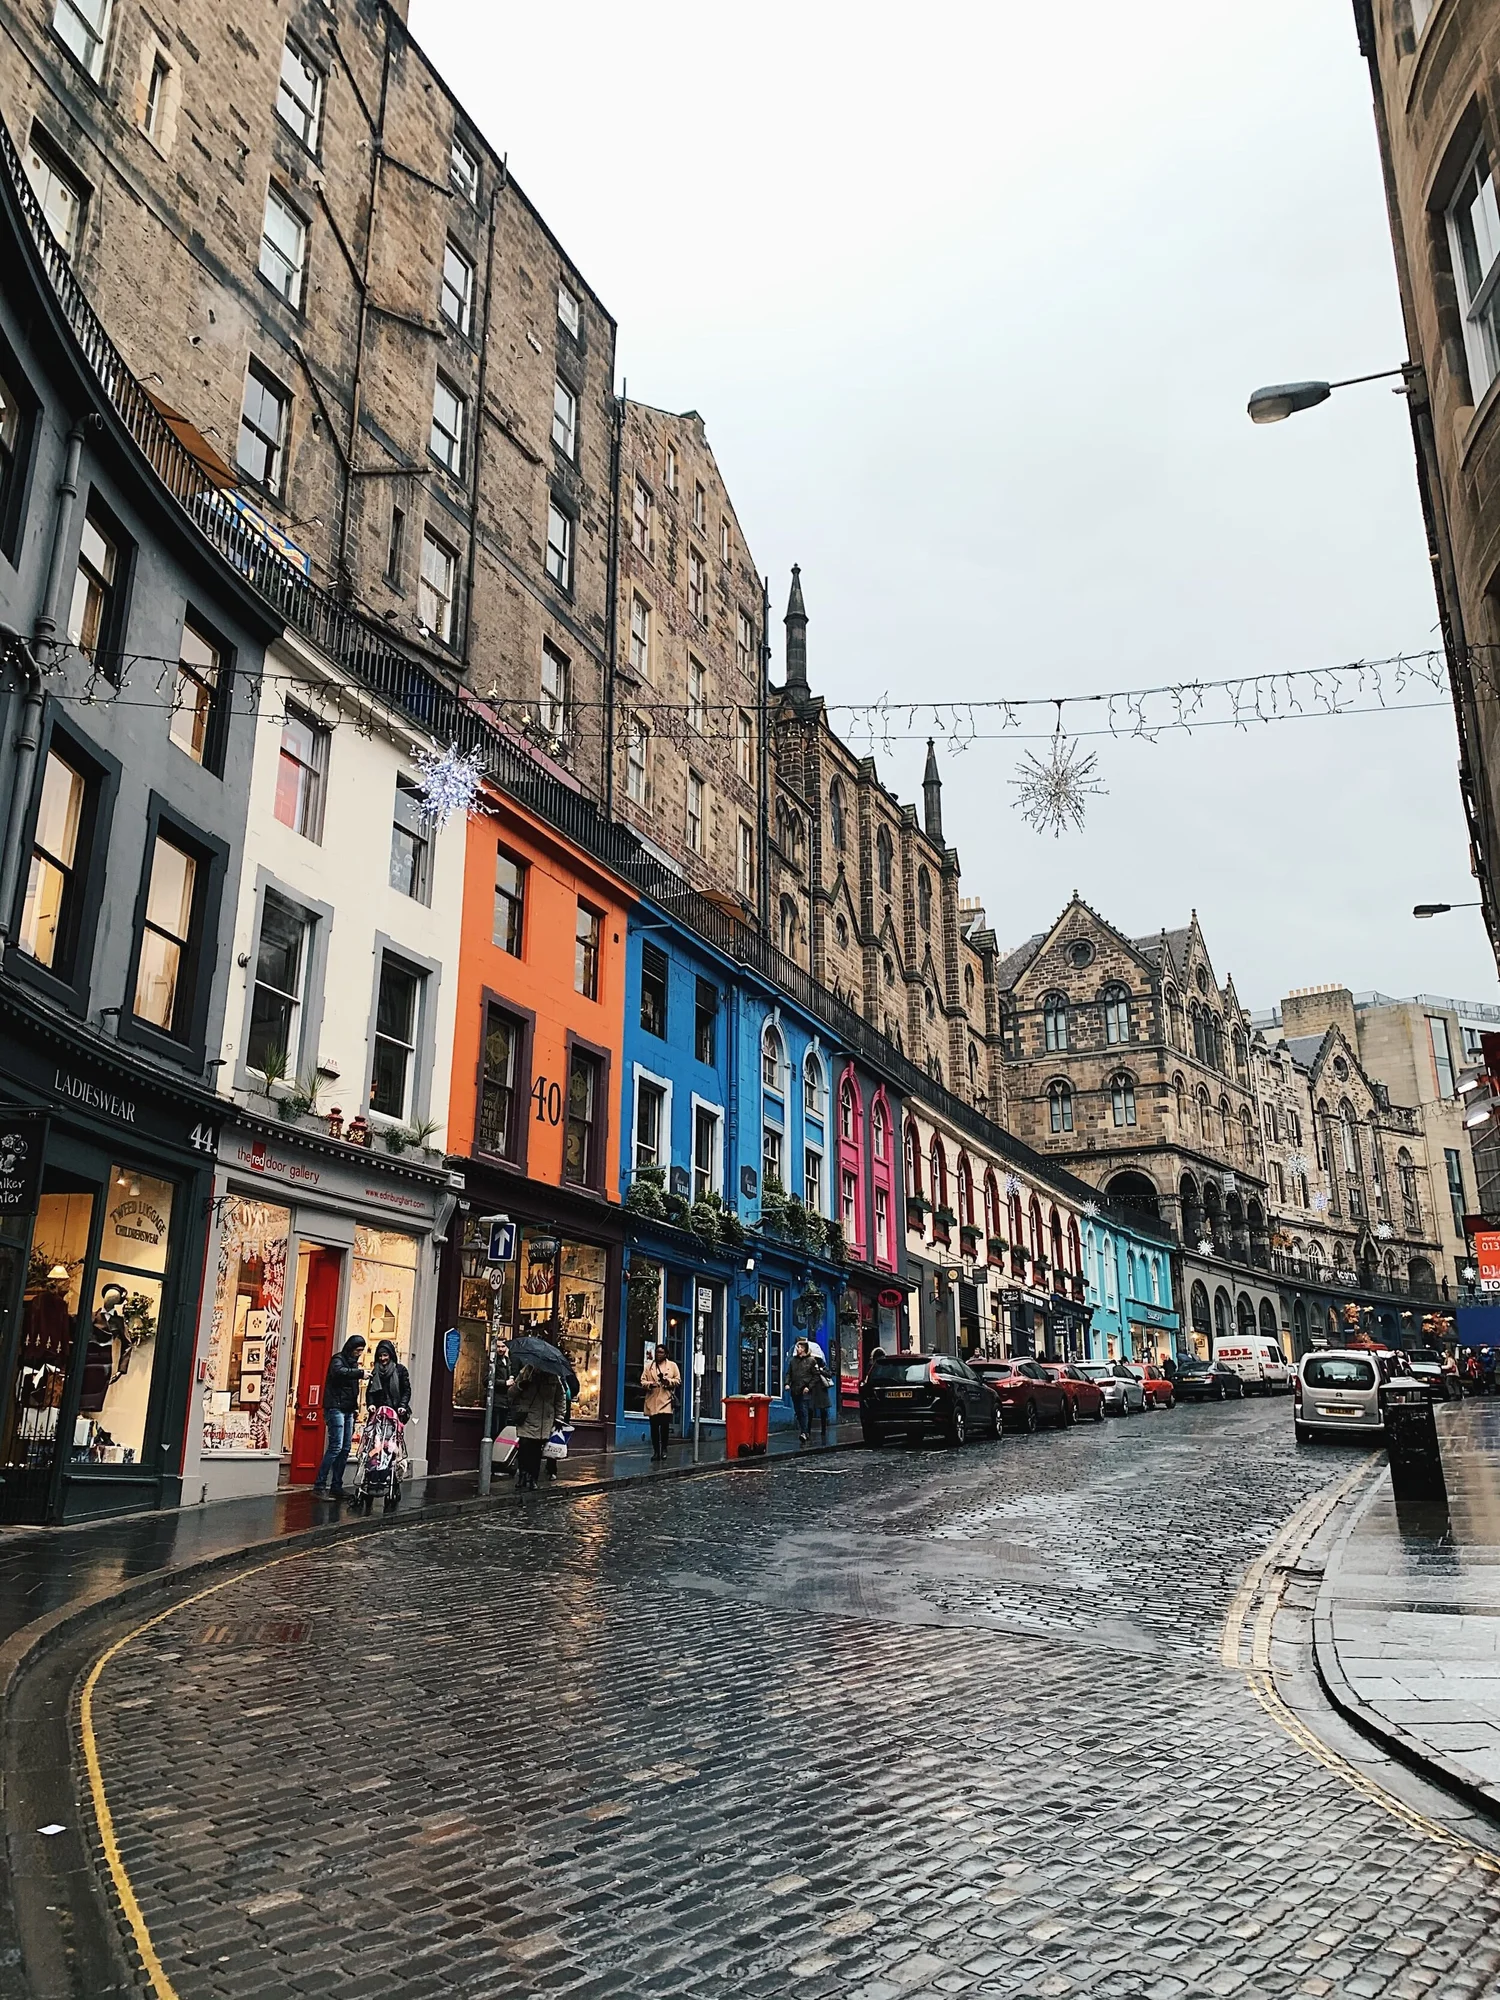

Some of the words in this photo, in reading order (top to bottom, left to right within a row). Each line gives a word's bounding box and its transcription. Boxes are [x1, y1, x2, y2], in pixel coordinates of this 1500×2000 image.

[54, 1069, 136, 1123] LADIESWEAR
[531, 1076, 561, 1126] 40
[237, 1146, 251, 1163] the
[252, 1152, 266, 1167] red
[266, 1156, 287, 1173] door
[289, 1164, 320, 1184] gallery
[365, 1189, 426, 1209] www.edinburghart.com
[110, 1201, 137, 1224] TWEED
[138, 1201, 166, 1236] LUGGAGE
[115, 1224, 159, 1245] CHILDRENSWEAR
[491, 1274, 501, 1285] 20
[1218, 1348, 1253, 1358] BDL
[306, 1411, 318, 1422] 42
